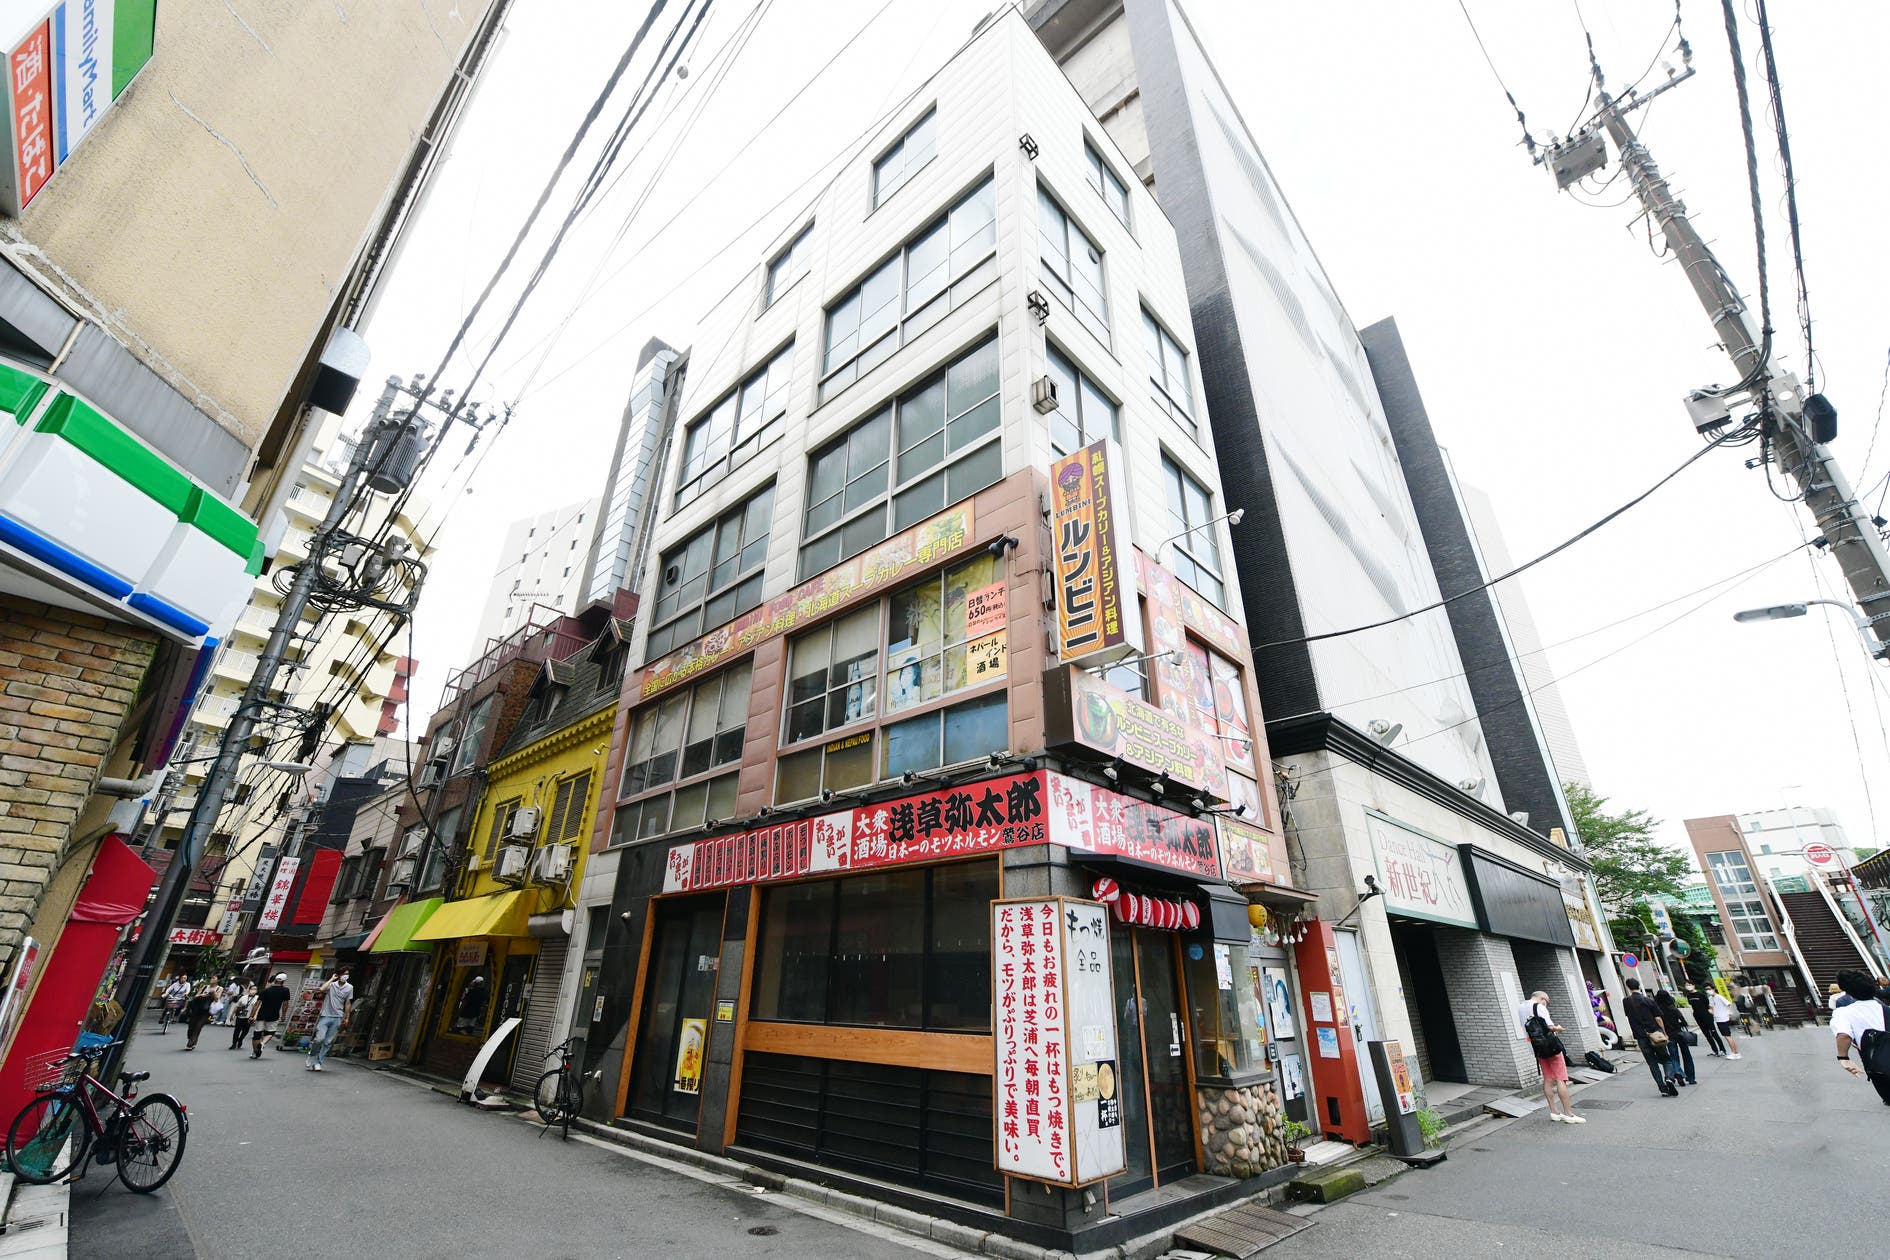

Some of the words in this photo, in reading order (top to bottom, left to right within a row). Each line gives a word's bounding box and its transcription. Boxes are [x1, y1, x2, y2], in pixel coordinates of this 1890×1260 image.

[16, 35, 47, 197] 酒・たばこ
[1055, 499, 1092, 519] LUMBINI
[968, 586, 1006, 609] 日替ランチ
[1061, 518, 1099, 650] ルンビニ
[969, 637, 999, 654] ネパール
[985, 643, 1007, 658] インド
[976, 657, 1000, 674] 酒場
[1127, 700, 1185, 739] 北海道で有名な
[1126, 742, 1195, 782] &アジアン料理
[856, 810, 888, 836] 大衆
[889, 776, 1042, 843] 浅草弥太郎
[1095, 795, 1124, 823] 大衆
[825, 823, 836, 859] うまい
[854, 833, 888, 860] 酒場
[888, 829, 1001, 859] 日本一のモツホルモン
[1098, 822, 1127, 850] 酒場
[1377, 829, 1407, 857] Dance
[1127, 842, 1198, 871] 日本一のモツホルモン
[1384, 856, 1437, 905] 新世紀
[264, 879, 290, 922] 錦華楼
[1000, 908, 1020, 1162] だから、モツがぷりっぷりで美味い。
[1019, 906, 1042, 1145] 浅草弥太郎は芝浦へ毎朝直買、
[1040, 903, 1066, 1178] 今日もお疲れの一杯はもつ焼きで。
